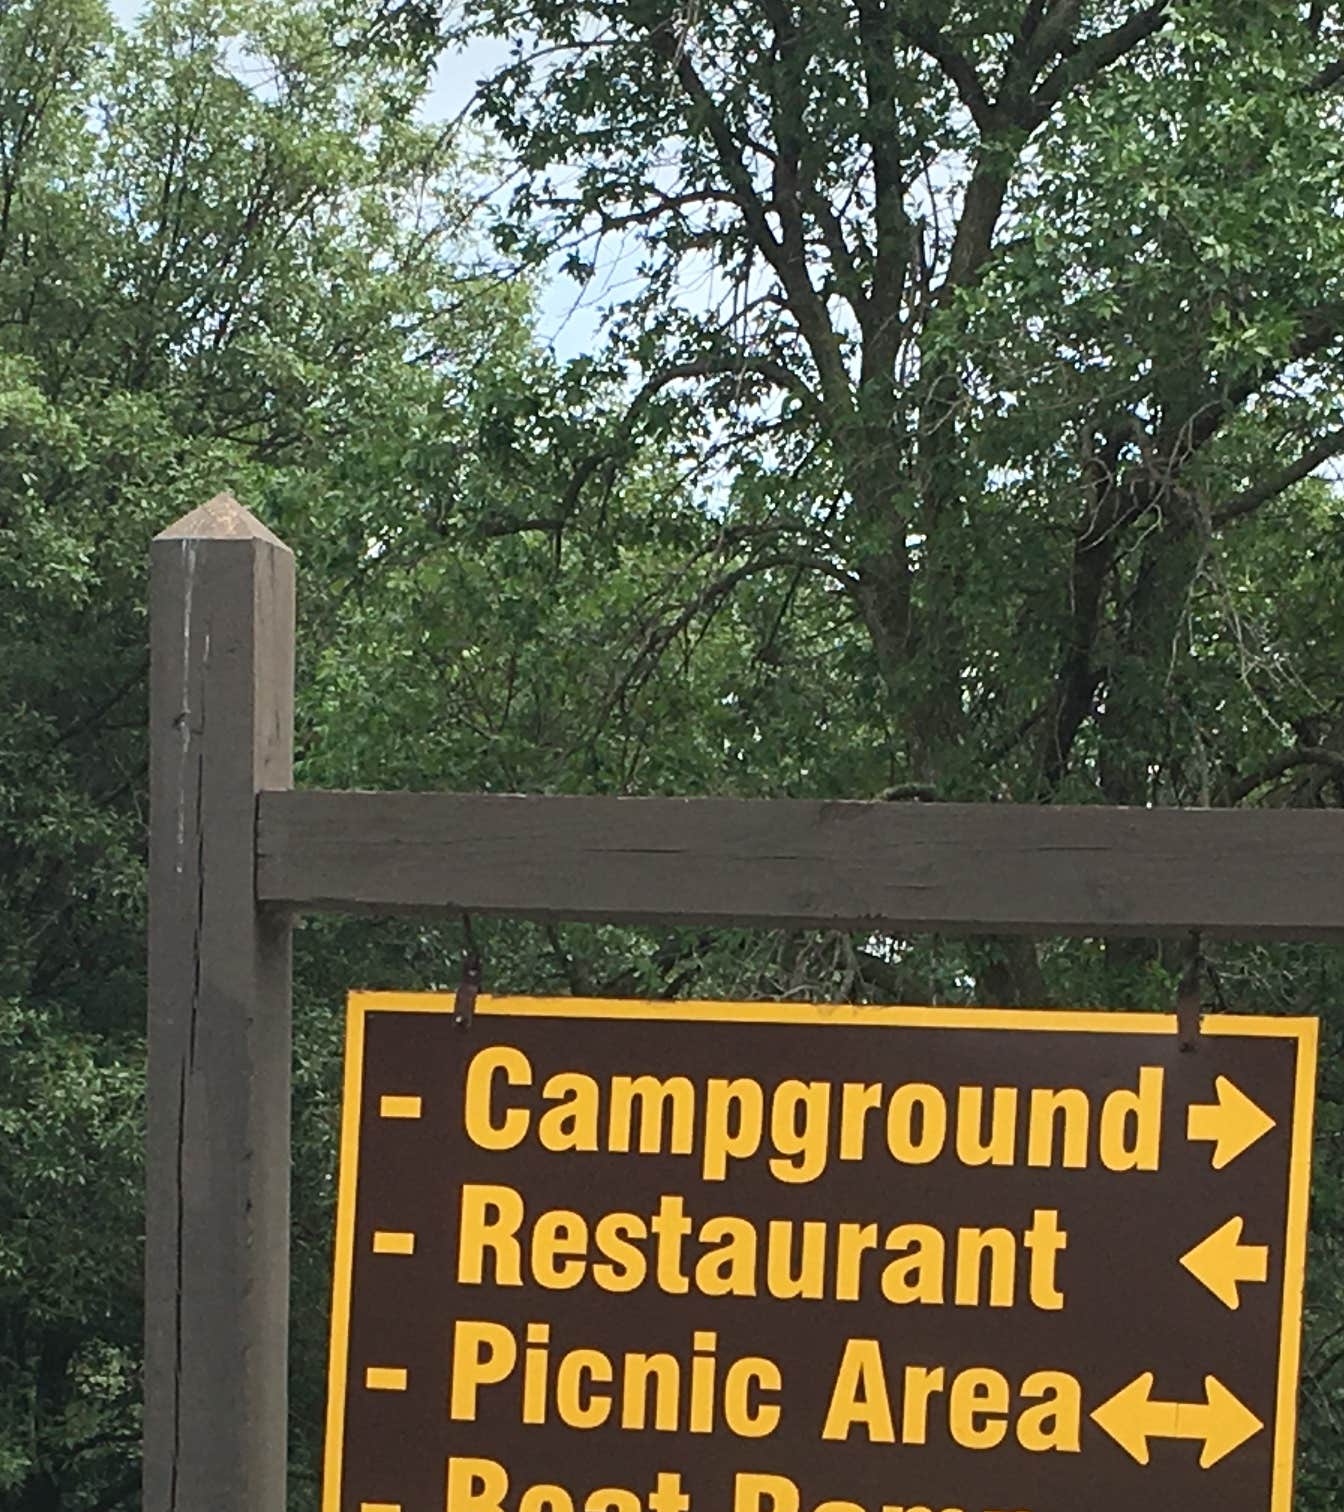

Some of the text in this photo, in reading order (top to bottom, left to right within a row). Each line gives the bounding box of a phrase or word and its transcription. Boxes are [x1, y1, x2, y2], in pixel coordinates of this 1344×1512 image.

[465, 1046, 1165, 1183] Campground
[457, 1184, 1067, 1310] Restaurant
[450, 1320, 1082, 1453] Picnic Area
